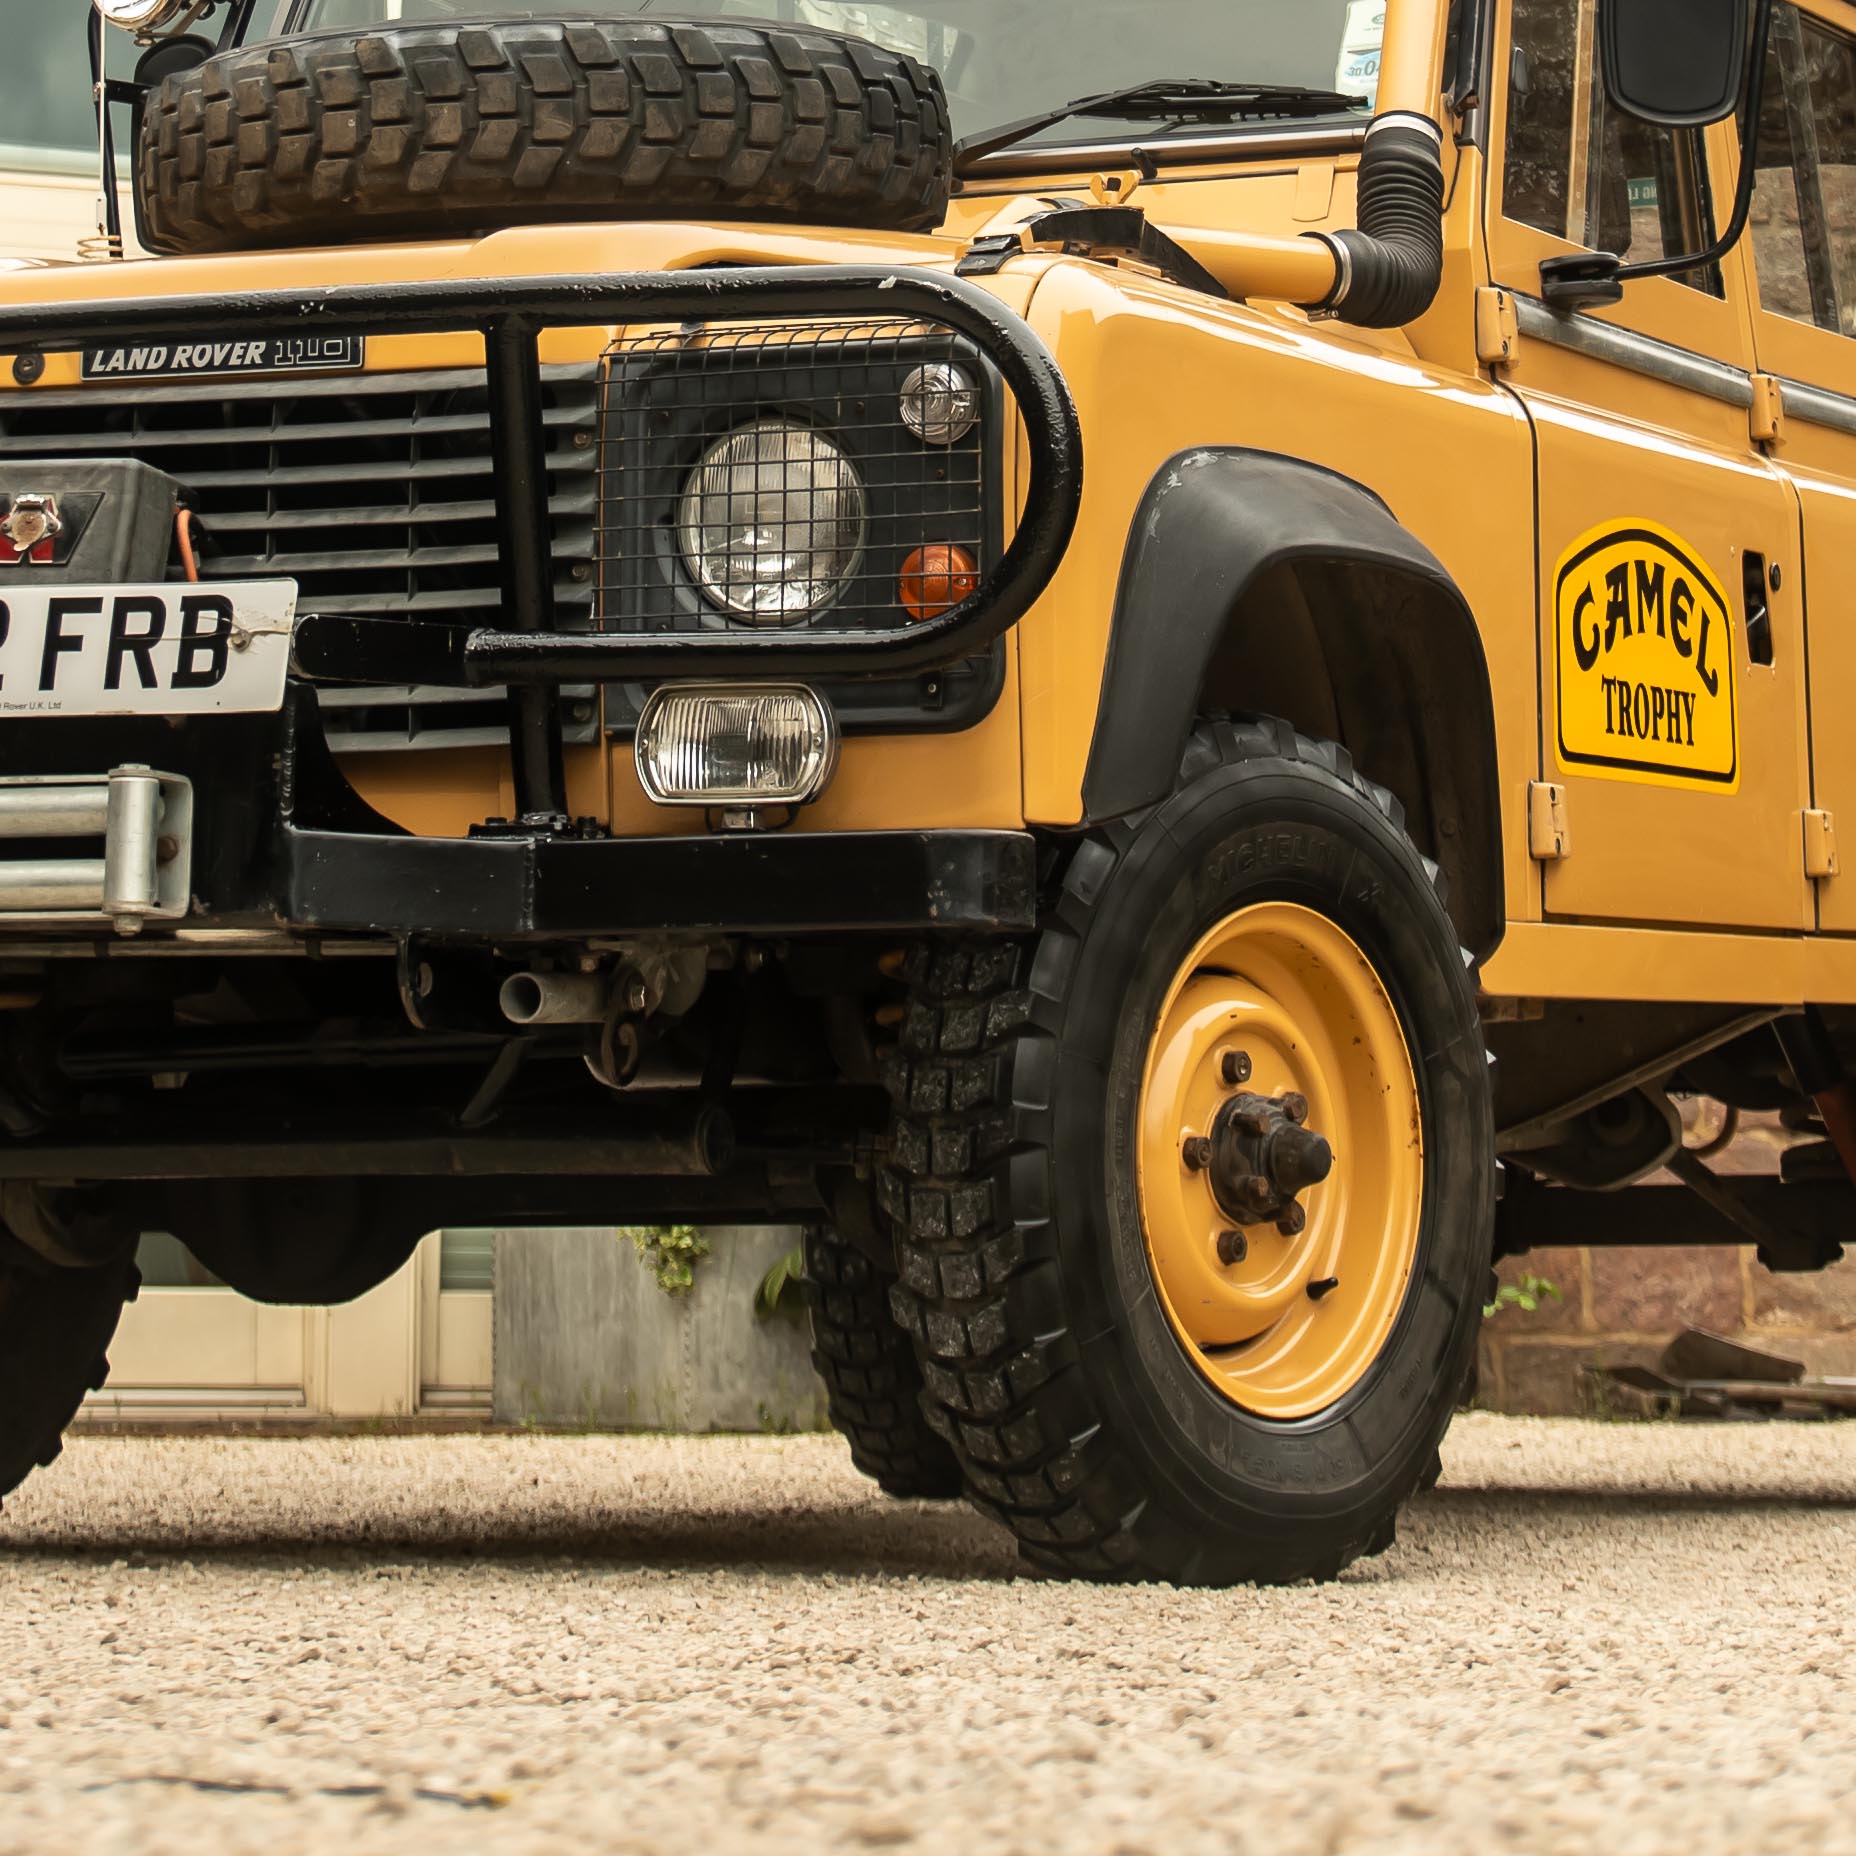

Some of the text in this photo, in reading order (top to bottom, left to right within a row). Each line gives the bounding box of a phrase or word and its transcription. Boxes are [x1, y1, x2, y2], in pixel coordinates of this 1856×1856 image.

[90, 345, 168, 373] LAND
[170, 341, 267, 369] ROVER
[38, 593, 235, 693] FRB
[1572, 559, 1719, 698] CAMEL
[4, 702, 27, 711] Rover
[48, 701, 62, 710] Ltd
[1601, 674, 1697, 746] TROPHY
